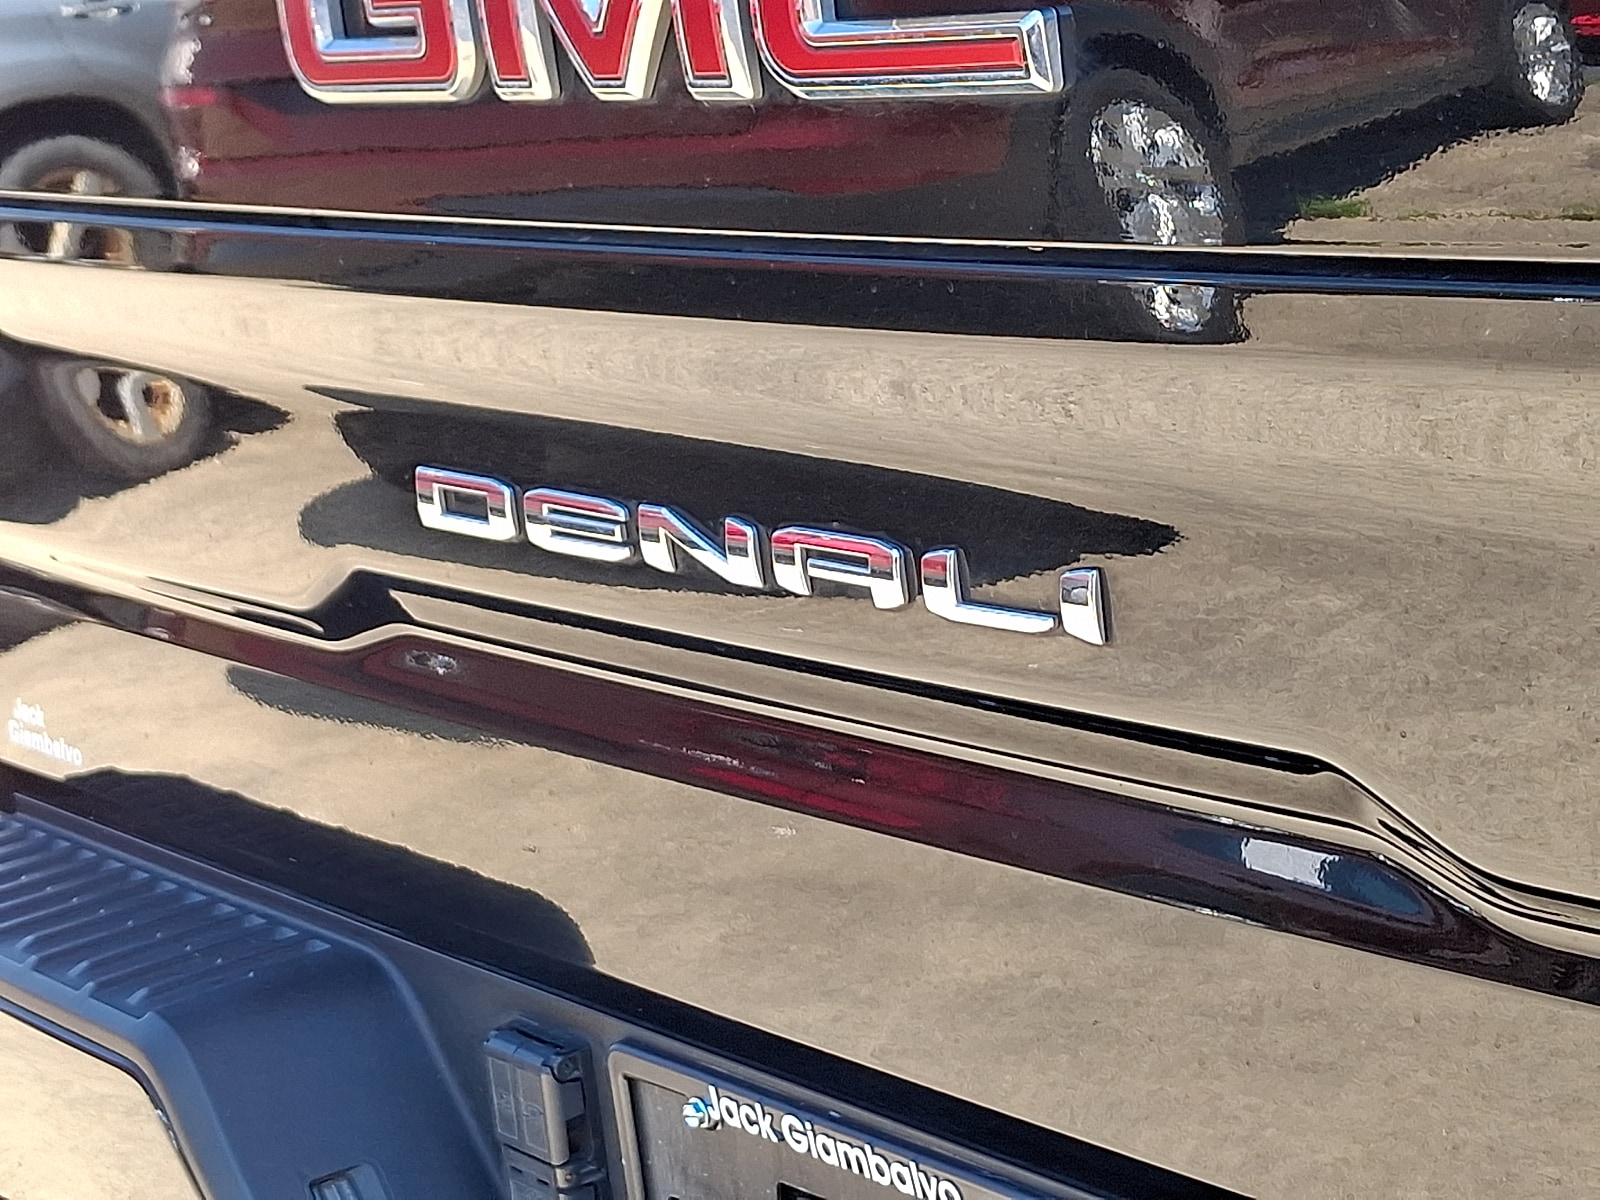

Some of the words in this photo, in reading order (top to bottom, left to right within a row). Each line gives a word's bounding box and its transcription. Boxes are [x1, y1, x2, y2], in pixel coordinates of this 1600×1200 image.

[414, 465, 1107, 645] DENALI
[7, 719, 83, 766] Giambalvo
[13, 697, 45, 729] Jack
[704, 1084, 780, 1143] Jack
[781, 1113, 963, 1200] Giambalvo
